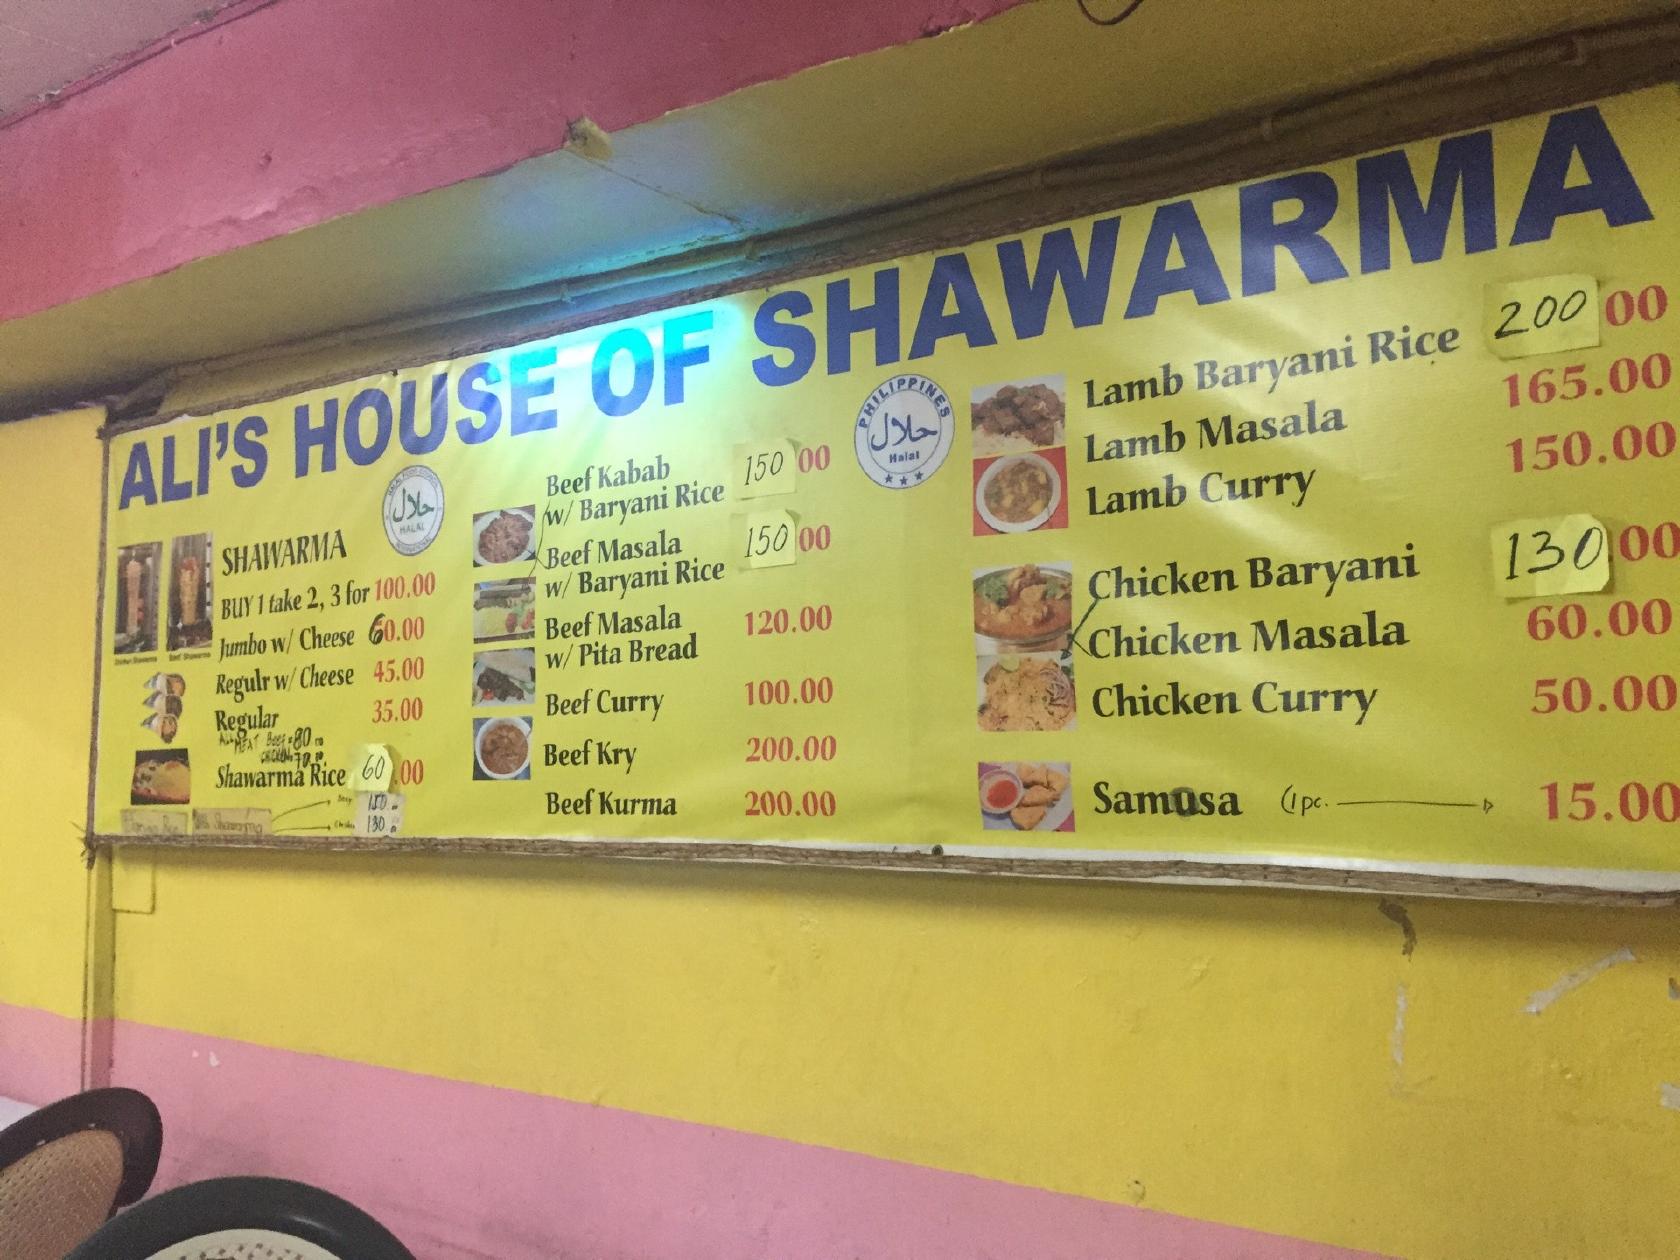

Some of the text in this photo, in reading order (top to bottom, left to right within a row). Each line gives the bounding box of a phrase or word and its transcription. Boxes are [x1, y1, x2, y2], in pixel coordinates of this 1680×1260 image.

[119, 106, 1654, 510] ALI'S HOUSE OF SHAWARMA
[1494, 290, 1587, 339] 200
[1084, 325, 1460, 408] Lamb Baryani Rice
[1502, 353, 1672, 408] 165.00
[859, 377, 950, 429] PHILIPPINES
[1084, 400, 1347, 463] Lamb Masala
[1505, 421, 1677, 473] 150.00
[546, 454, 670, 497] Beef Kabab
[745, 451, 784, 486] 150
[889, 451, 919, 463] Halal
[545, 481, 725, 527] w/ Baryani Rice
[1086, 469, 1316, 516] Lamb Curry
[222, 529, 347, 576] SHAWARMA
[546, 529, 682, 569] Beef Masala
[744, 524, 788, 558] 150
[1505, 526, 1603, 580] 130
[545, 557, 725, 600] w/ Baryani Rice
[1088, 543, 1420, 600] Chicken Baryani
[221, 571, 435, 620] BUY 1 take 2, 3 for 100.00
[219, 613, 424, 662] Jumbo w/ Cheese 60.00
[544, 604, 682, 640] Beef Masala
[745, 604, 832, 636] 120.00
[1089, 610, 1410, 659] Chicken Masala
[1527, 598, 1672, 641] 60.00
[545, 632, 699, 670] w/ Pita Bread
[216, 656, 424, 703] Regulr w/ Cheese 45.00
[745, 677, 833, 706] 100.00
[1531, 674, 1677, 714] 50.00
[215, 697, 423, 740] Regular 35.00
[546, 688, 664, 722] Beef Curry
[1092, 681, 1378, 726] Chicken Curry
[362, 754, 385, 780] 60
[543, 739, 637, 775] Beef Kry
[745, 735, 837, 763] 200.00
[216, 761, 346, 788] Shawarma Rice
[545, 788, 677, 816] Beef Kurma
[744, 791, 837, 817] 200.00
[1540, 781, 1680, 822] 15.00
